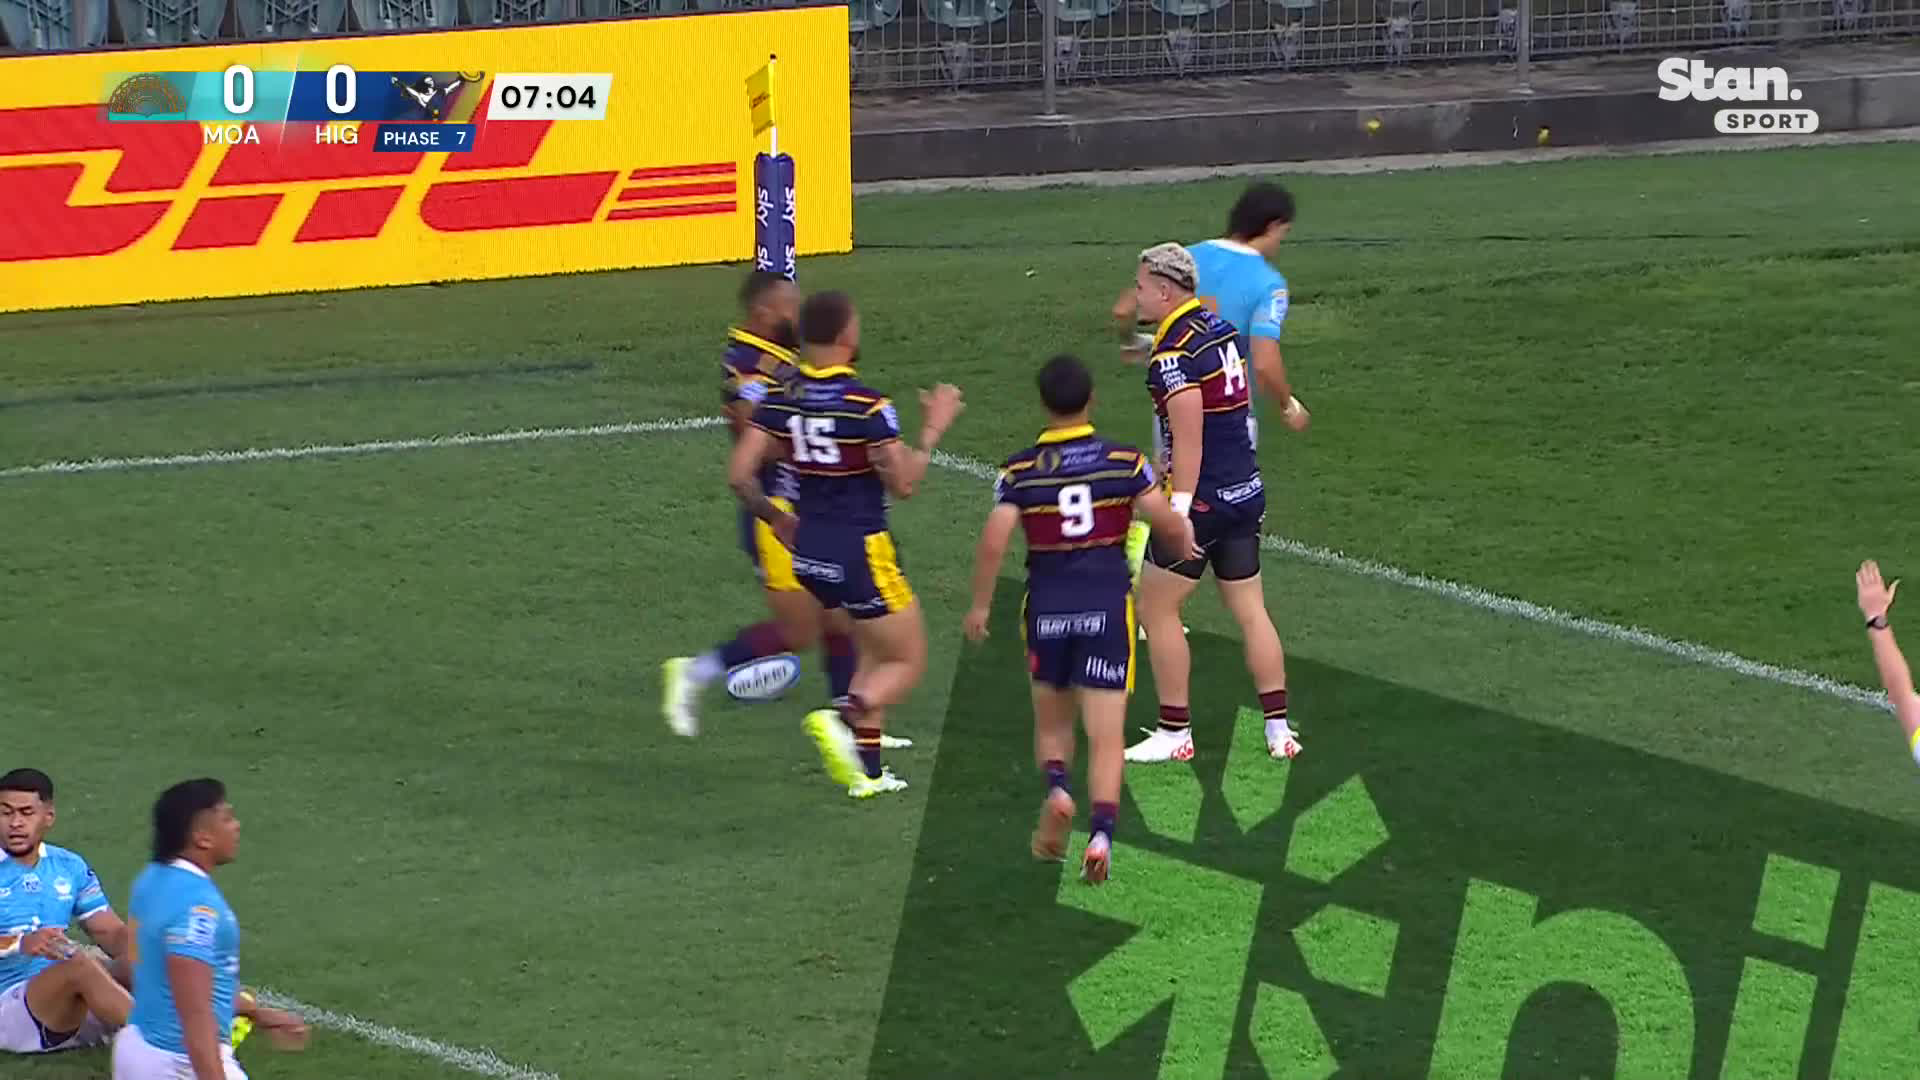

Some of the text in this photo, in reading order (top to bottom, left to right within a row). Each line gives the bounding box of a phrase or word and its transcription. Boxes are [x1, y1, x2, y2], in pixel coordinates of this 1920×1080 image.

[757, 244, 774, 272] sk
[1217, 340, 1246, 397] 14
[786, 414, 842, 464] 15
[1057, 483, 1095, 537] 9
[1428, 853, 1920, 1080] ni
